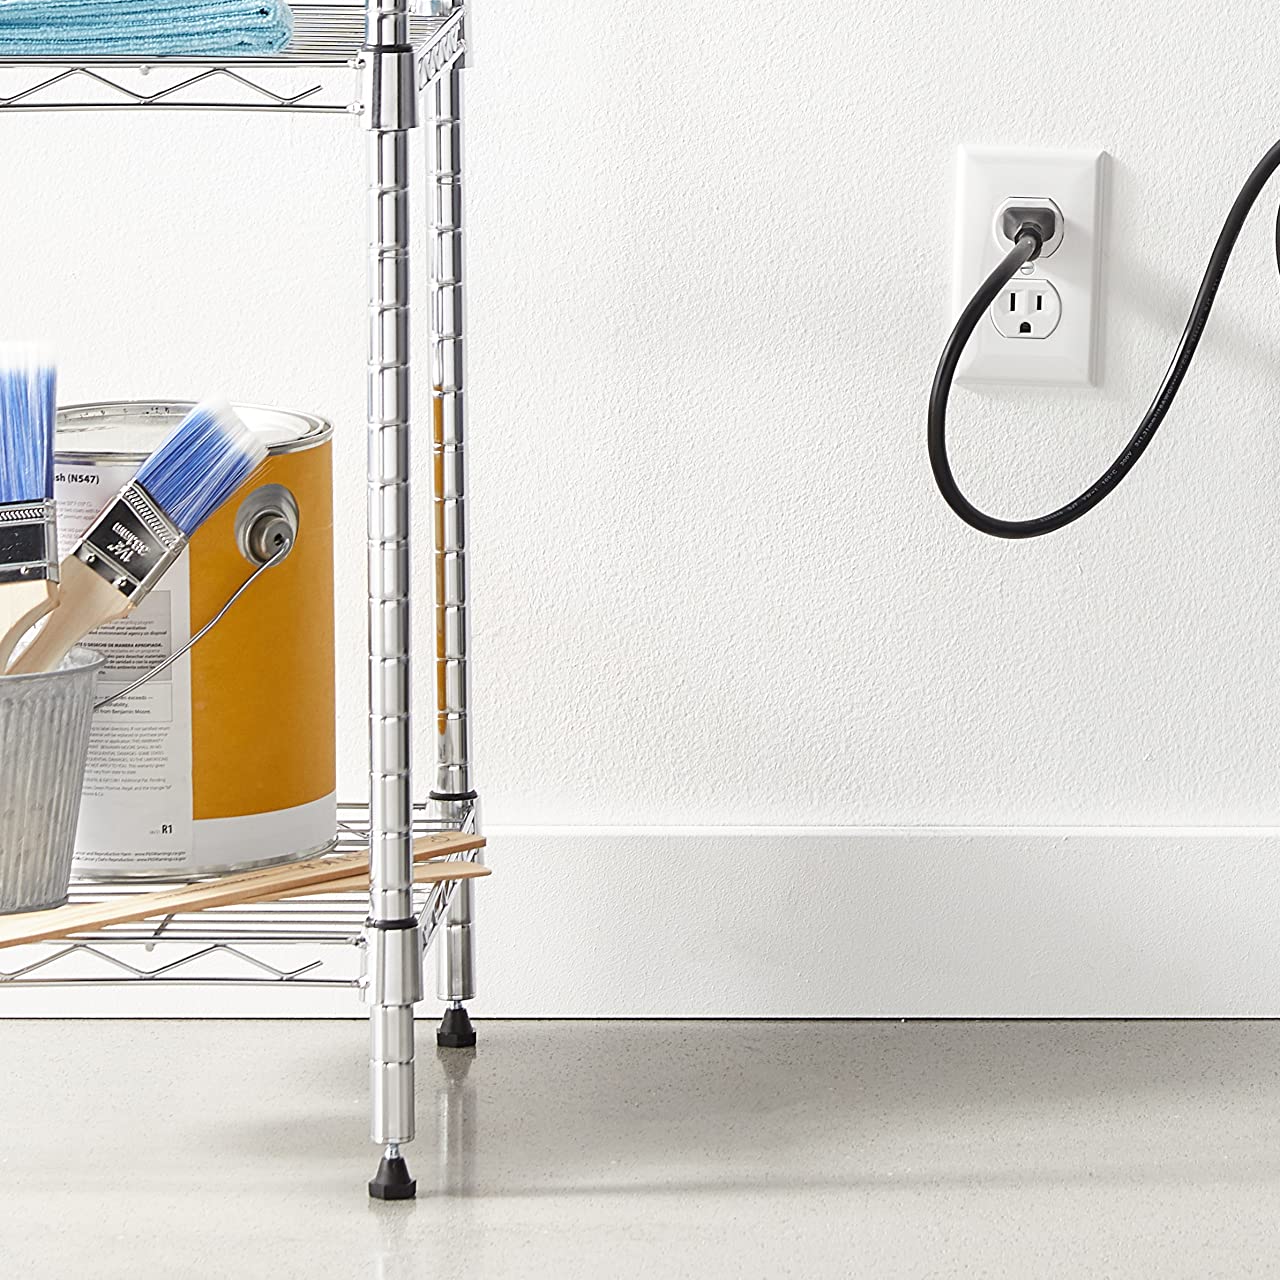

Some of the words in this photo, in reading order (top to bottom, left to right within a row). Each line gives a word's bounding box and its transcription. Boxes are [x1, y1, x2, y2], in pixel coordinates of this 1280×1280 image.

[55, 474, 65, 482] sh
[68, 474, 100, 484] (N547)
[162, 824, 172, 834] R1
